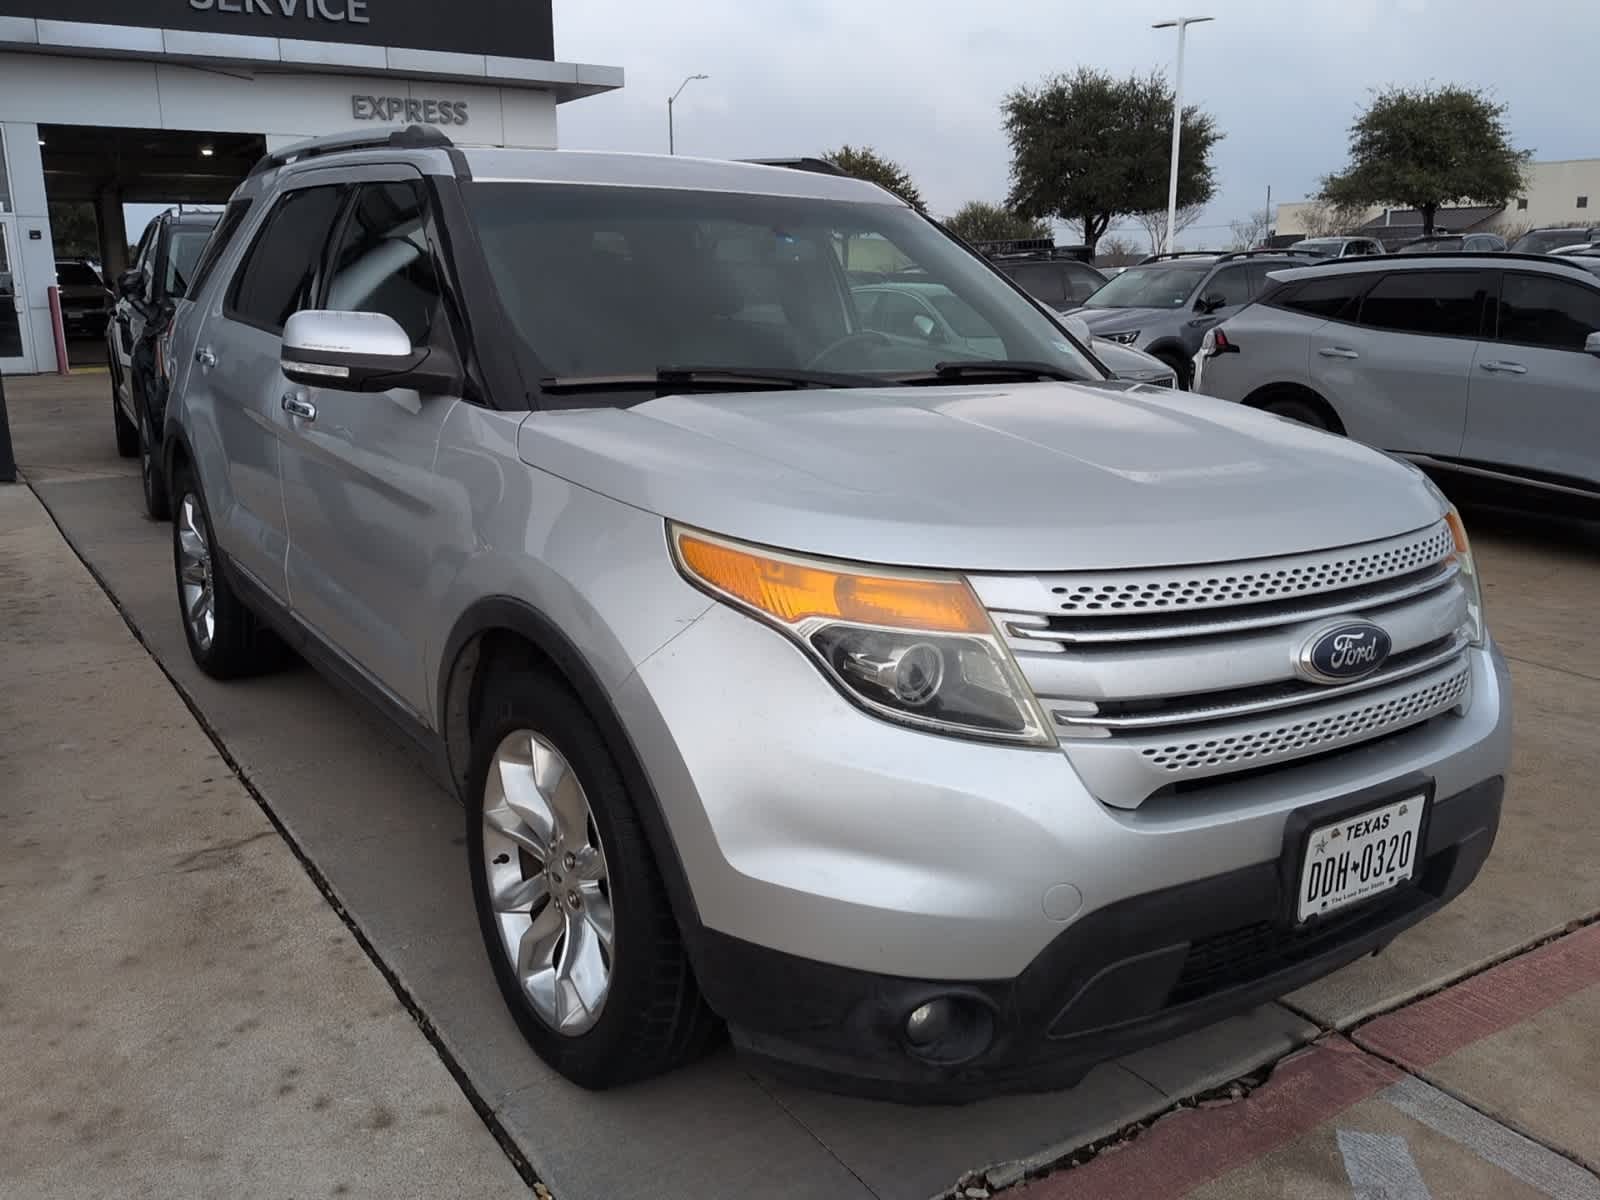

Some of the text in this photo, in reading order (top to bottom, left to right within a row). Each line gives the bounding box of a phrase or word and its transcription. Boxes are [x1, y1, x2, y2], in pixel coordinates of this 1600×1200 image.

[189, 0, 370, 23] VICE
[351, 95, 468, 125] EXPRESS
[1331, 632, 1377, 669] Ford
[1346, 813, 1390, 840] TEXAS
